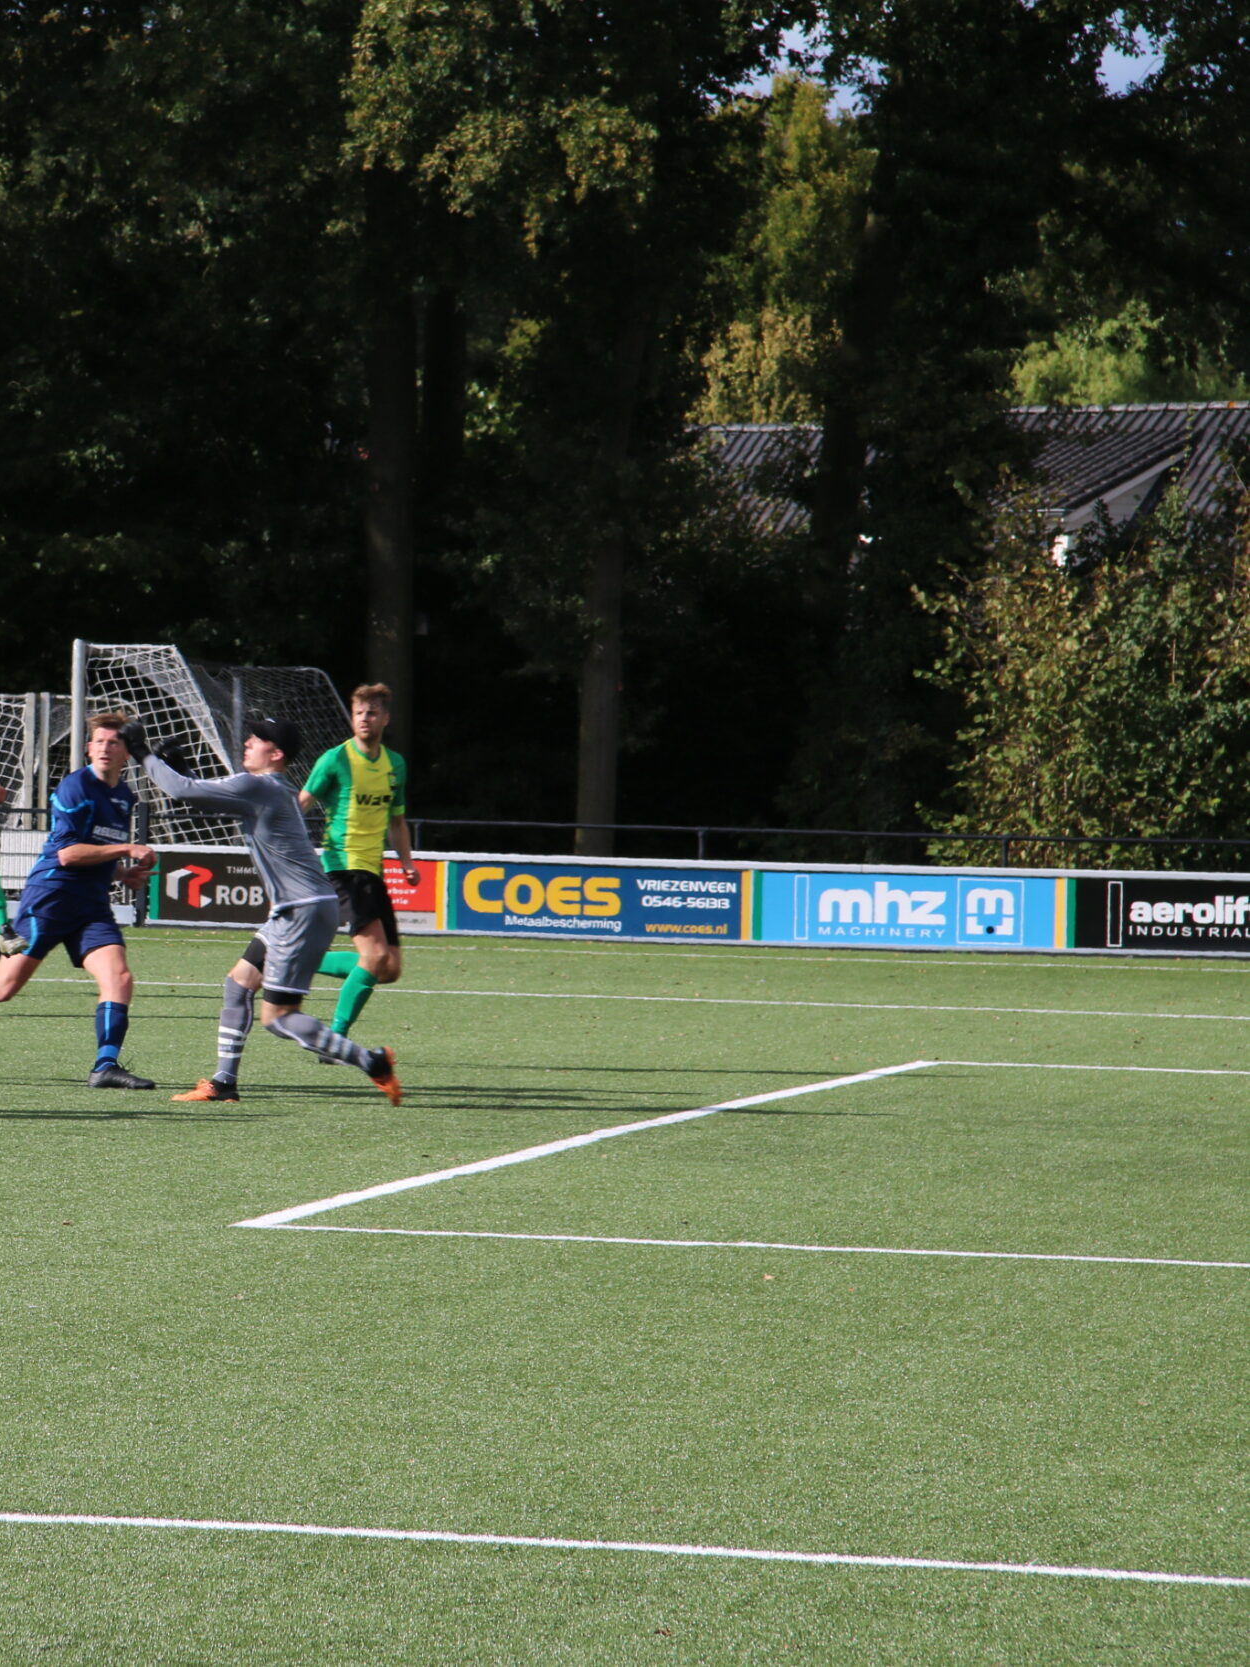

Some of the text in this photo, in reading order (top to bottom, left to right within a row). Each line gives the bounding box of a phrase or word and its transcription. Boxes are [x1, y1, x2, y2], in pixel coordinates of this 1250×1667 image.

[463, 867, 621, 916] COES
[637, 879, 737, 893] VRIEZENVEEN
[216, 885, 264, 906] ROB
[818, 881, 947, 925] mhz
[1129, 895, 1250, 925] aerolif
[505, 915, 622, 932] Metaalbescherming
[645, 922, 729, 935] www.coes.nl
[818, 926, 946, 938] MACHINERY
[1128, 925, 1250, 938] INDUSTRIAL
